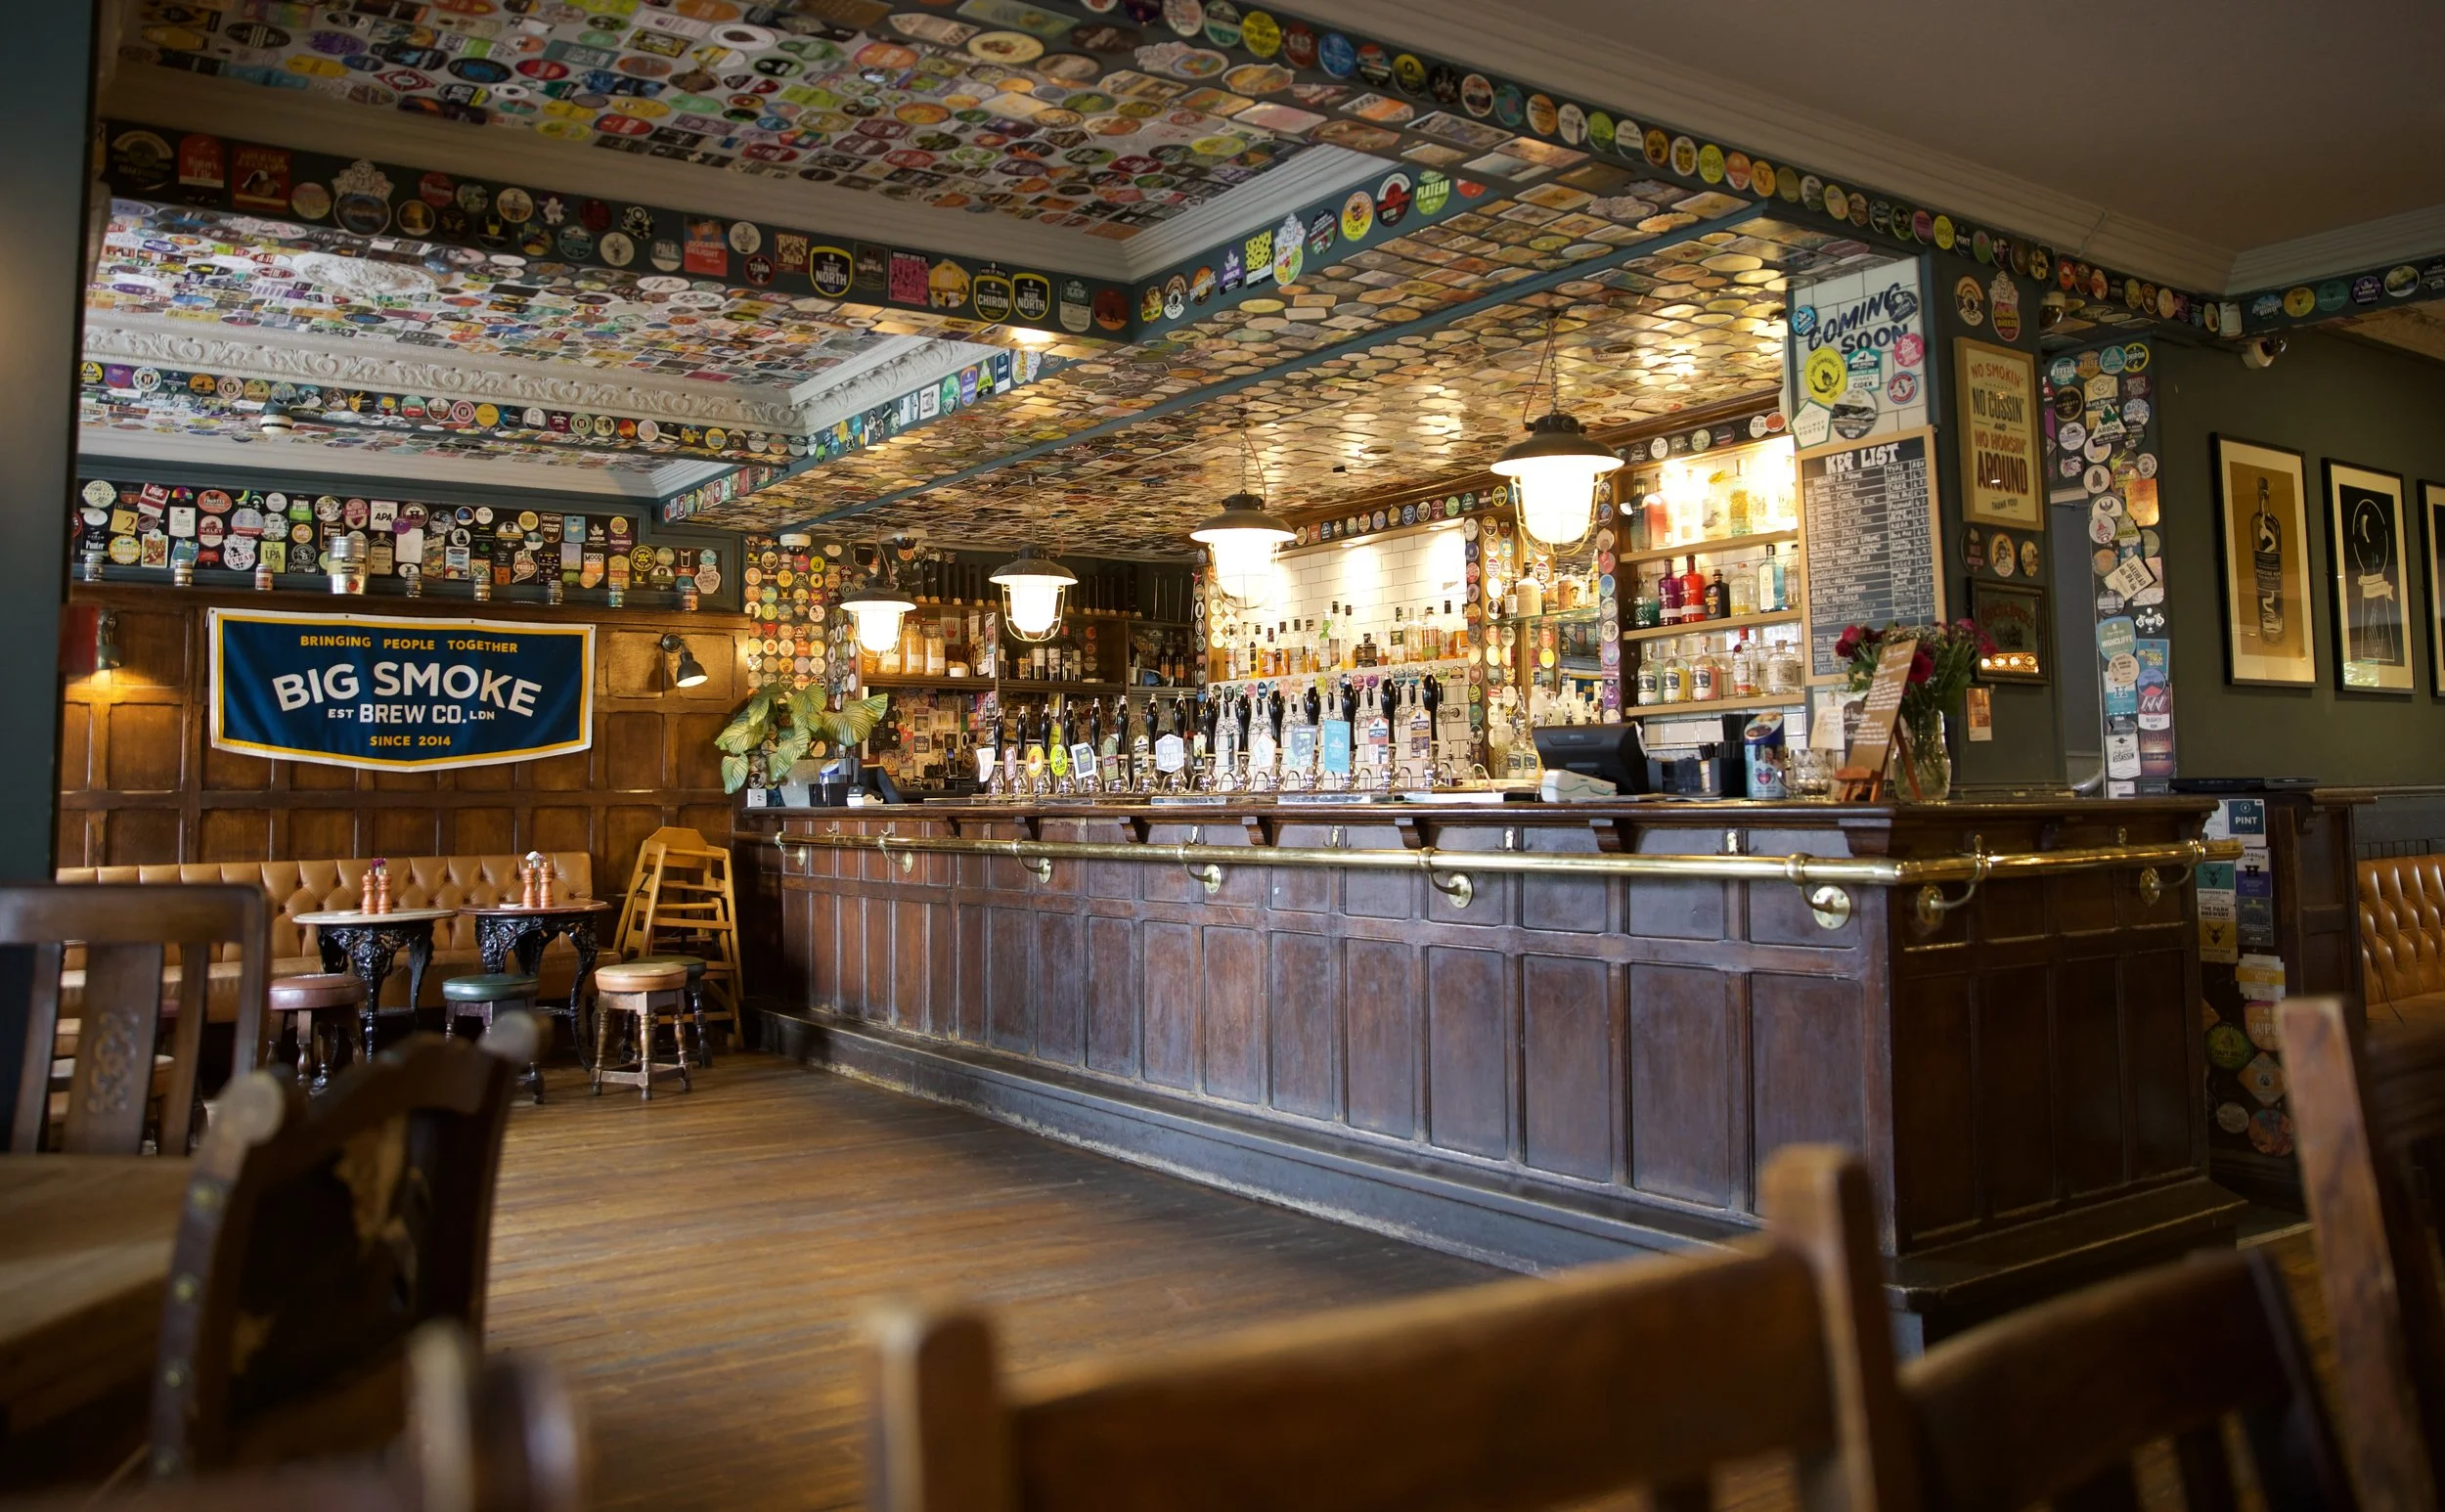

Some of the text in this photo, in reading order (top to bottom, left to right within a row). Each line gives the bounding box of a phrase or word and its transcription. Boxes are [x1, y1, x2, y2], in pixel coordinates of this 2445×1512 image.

[1417, 180, 1449, 200] PLATEAU
[656, 243, 676, 254] PALE
[686, 246, 719, 258] DELIGHT
[749, 262, 771, 273] TZARA
[816, 270, 847, 286] NORTH
[978, 293, 1008, 309] CHIRON
[1017, 297, 1045, 311] NORTH
[1808, 283, 1901, 351] COMING
[1841, 325, 1908, 354] SOON
[2079, 360, 2098, 369] ARISE
[1972, 364, 2023, 387] NO SMOKIN'
[1973, 387, 2024, 423] NO CUSSIN'
[1800, 421, 1824, 430] RAILWAY
[1800, 425, 1825, 436] PORTER
[1994, 422, 2007, 431] AND
[2097, 424, 2119, 433] ARBOR
[1975, 430, 1988, 448] NO
[1825, 442, 1899, 475] KEG LIST
[1978, 450, 2028, 495] AROUND
[125, 516, 134, 532] 2
[376, 512, 393, 522] APA
[227, 553, 254, 565] FUBAR
[265, 550, 281, 559] LPA
[2127, 562, 2147, 586] JAKEHEAD
[300, 635, 518, 653] BRINGING PEOPLE TOGETHER
[2101, 634, 2133, 647] HIGHCLIFFE
[272, 661, 543, 718] BIG SMOKE
[328, 704, 495, 724] EST BREW CO. LDN
[370, 735, 451, 747] SINCE 2014
[2112, 753, 2134, 763] ASSASSIN
[2235, 817, 2257, 825] PINT
